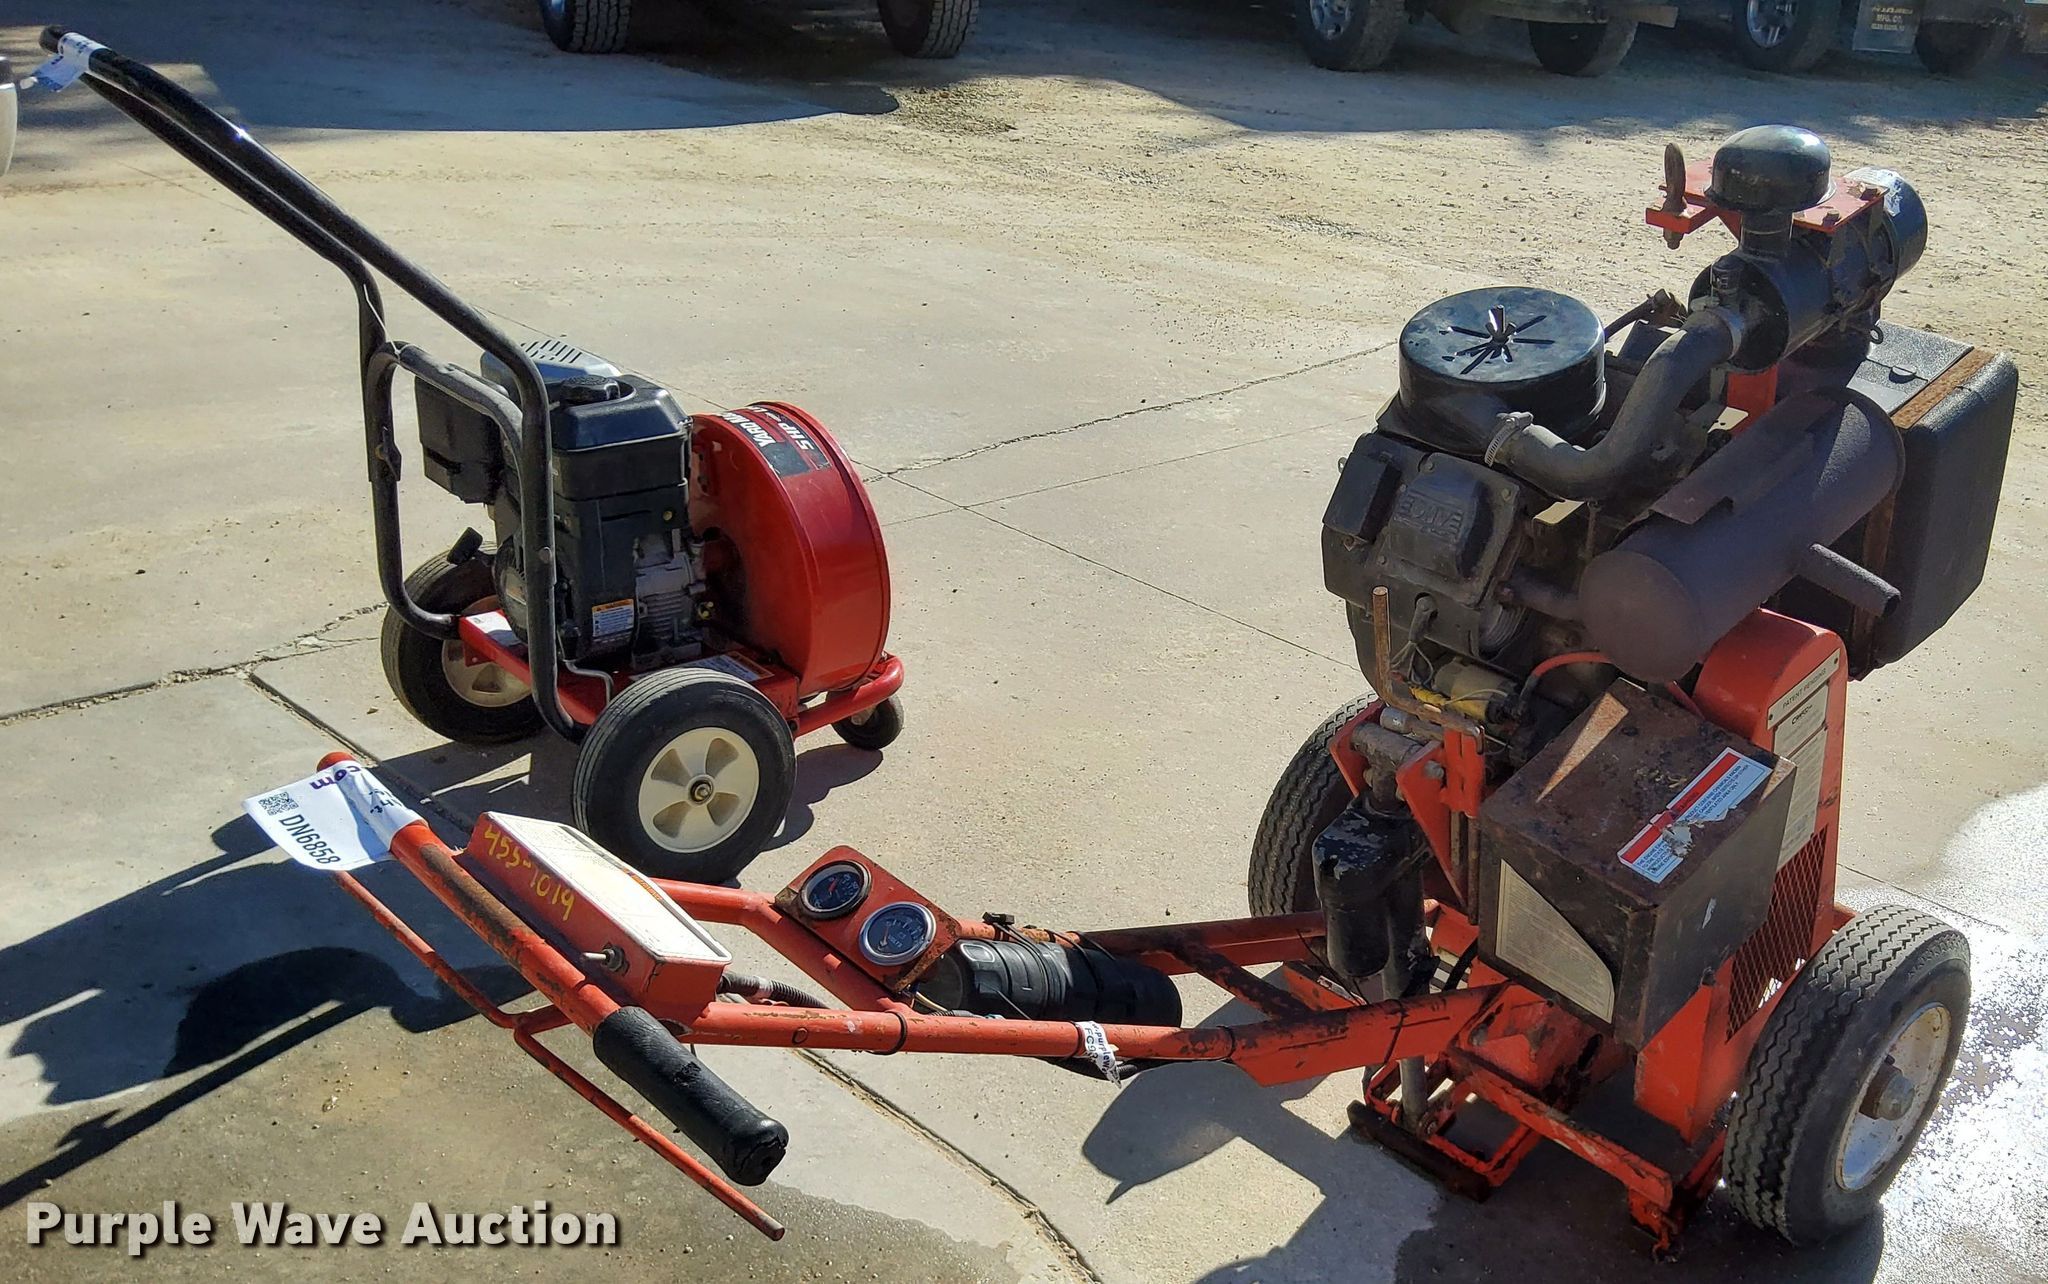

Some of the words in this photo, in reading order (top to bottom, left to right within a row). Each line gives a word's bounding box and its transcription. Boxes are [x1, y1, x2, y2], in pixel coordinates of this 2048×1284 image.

[721, 411, 777, 448] YARDM
[778, 422, 806, 439] HP
[279, 814, 341, 864] DN6858
